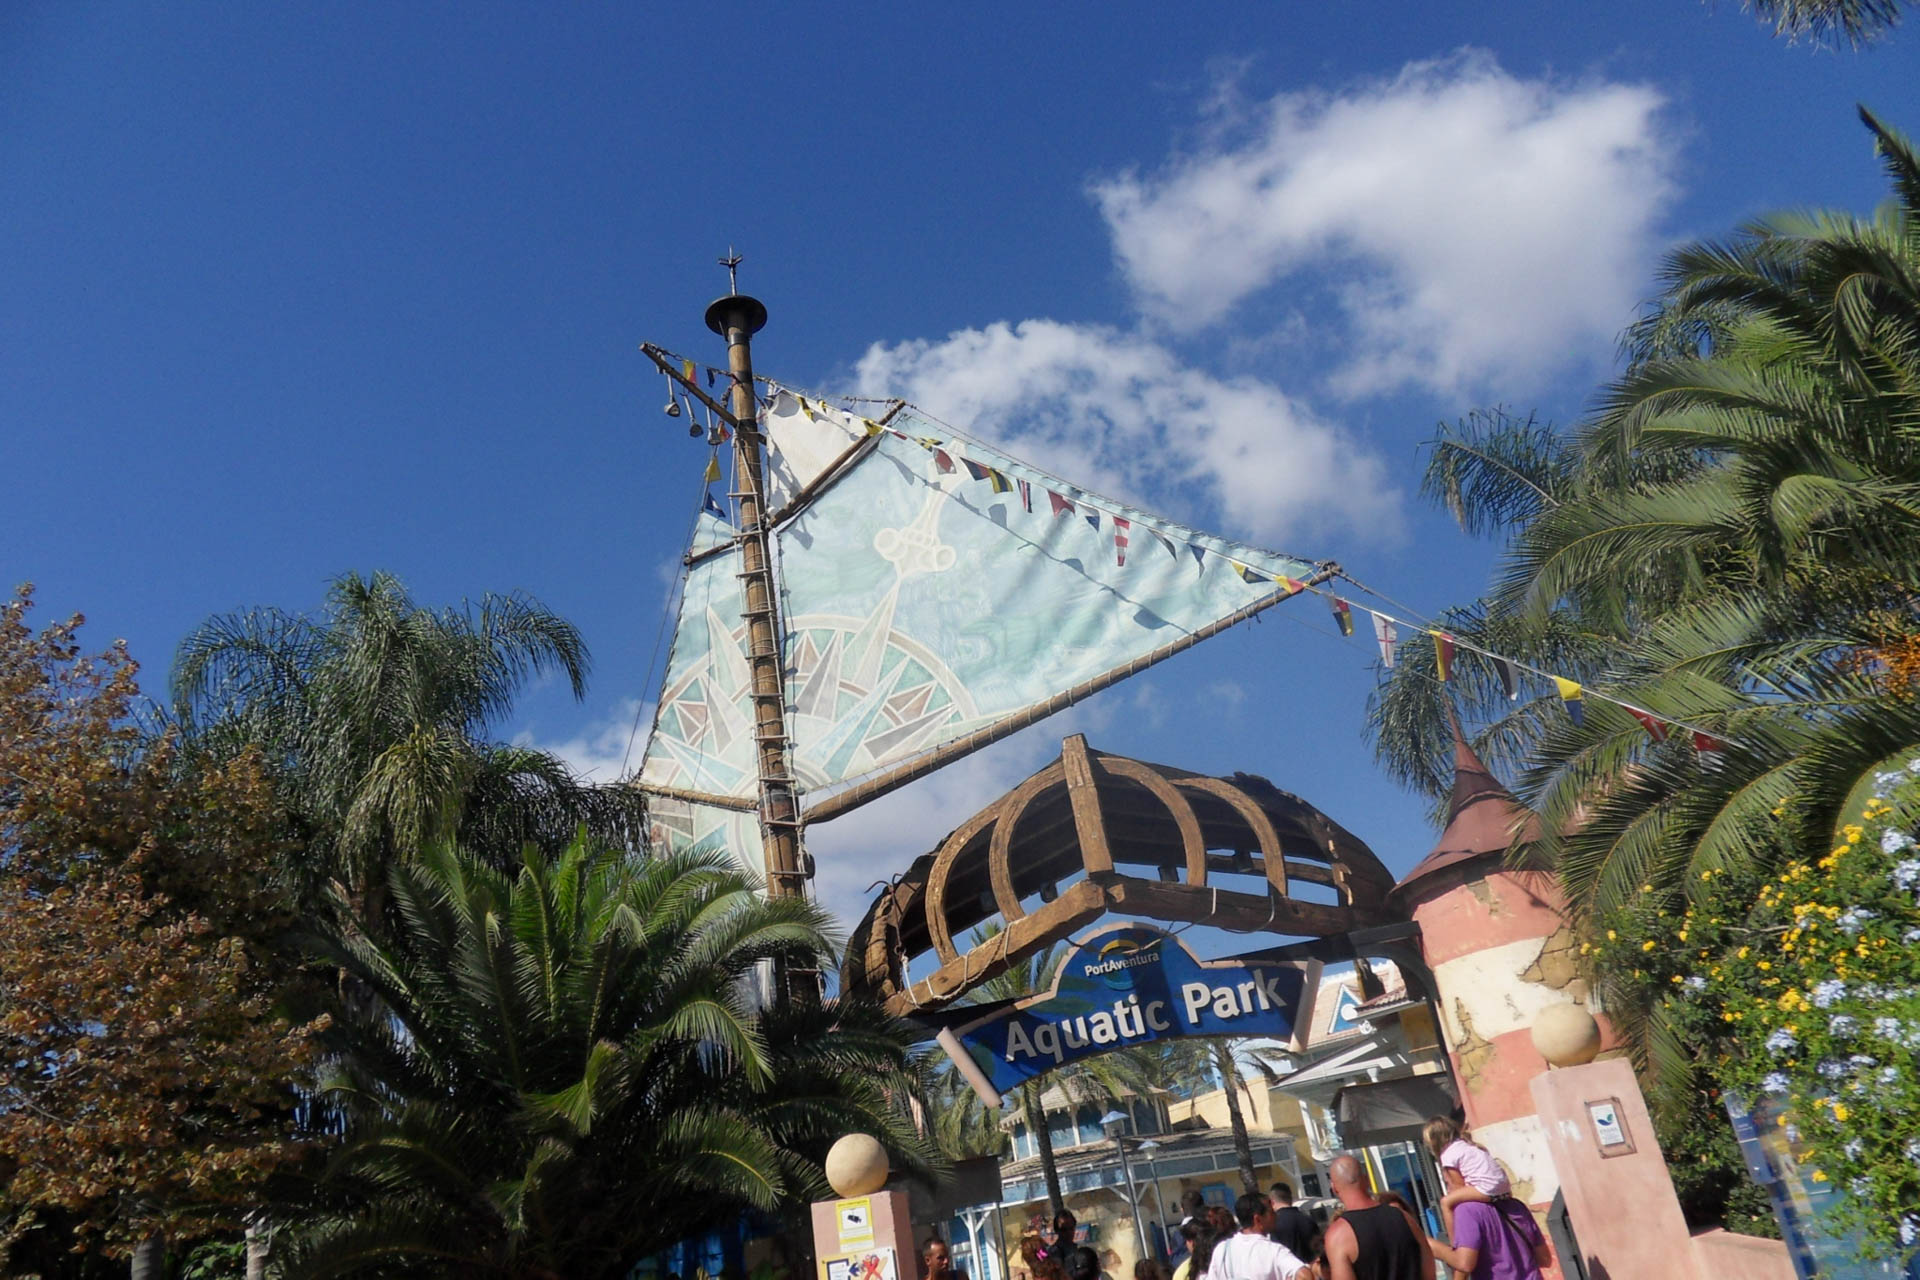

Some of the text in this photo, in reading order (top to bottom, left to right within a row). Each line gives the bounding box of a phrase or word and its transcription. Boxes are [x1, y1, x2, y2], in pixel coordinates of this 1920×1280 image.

[1084, 951, 1160, 978] PortAventura
[1005, 969, 1288, 1063] Aquatic Park
